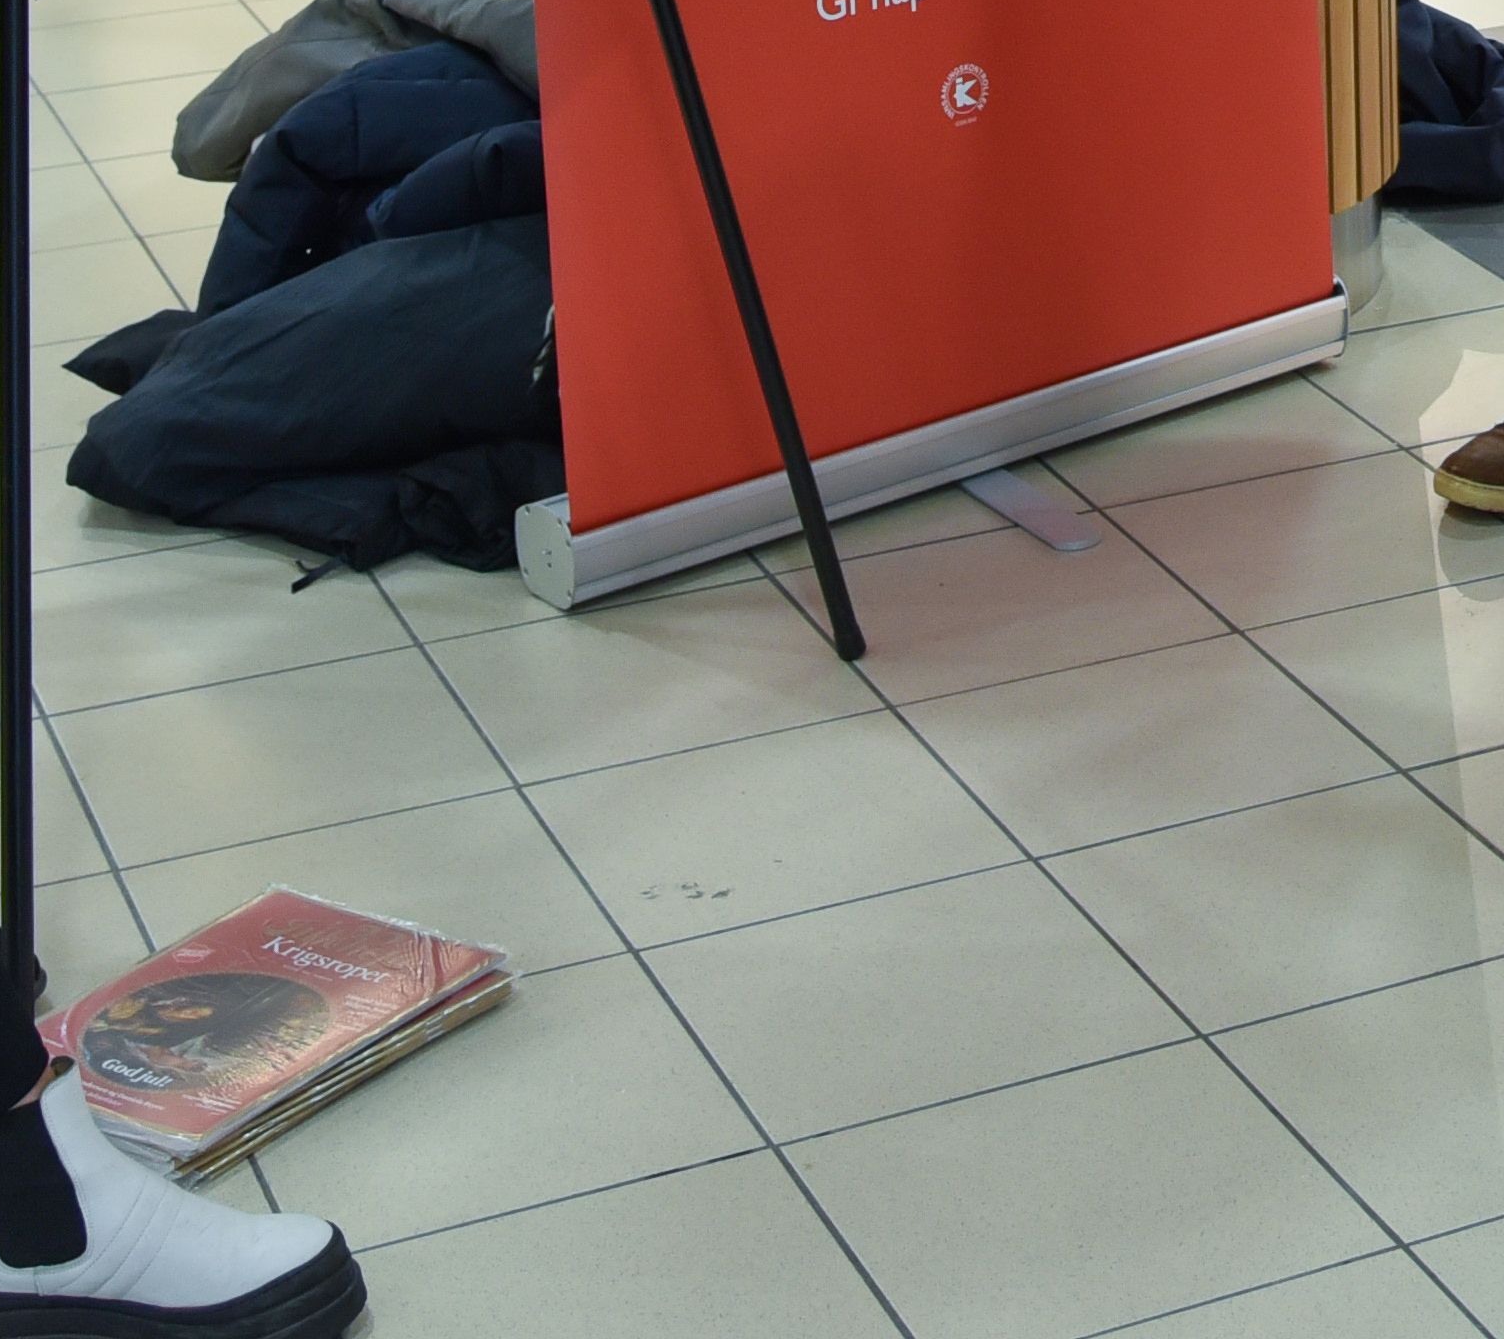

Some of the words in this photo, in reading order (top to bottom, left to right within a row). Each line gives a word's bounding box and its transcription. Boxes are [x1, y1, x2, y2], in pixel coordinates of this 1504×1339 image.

[261, 935, 391, 984] Krigsropet
[101, 1058, 137, 1078] God
[130, 1067, 173, 1088] jul!
